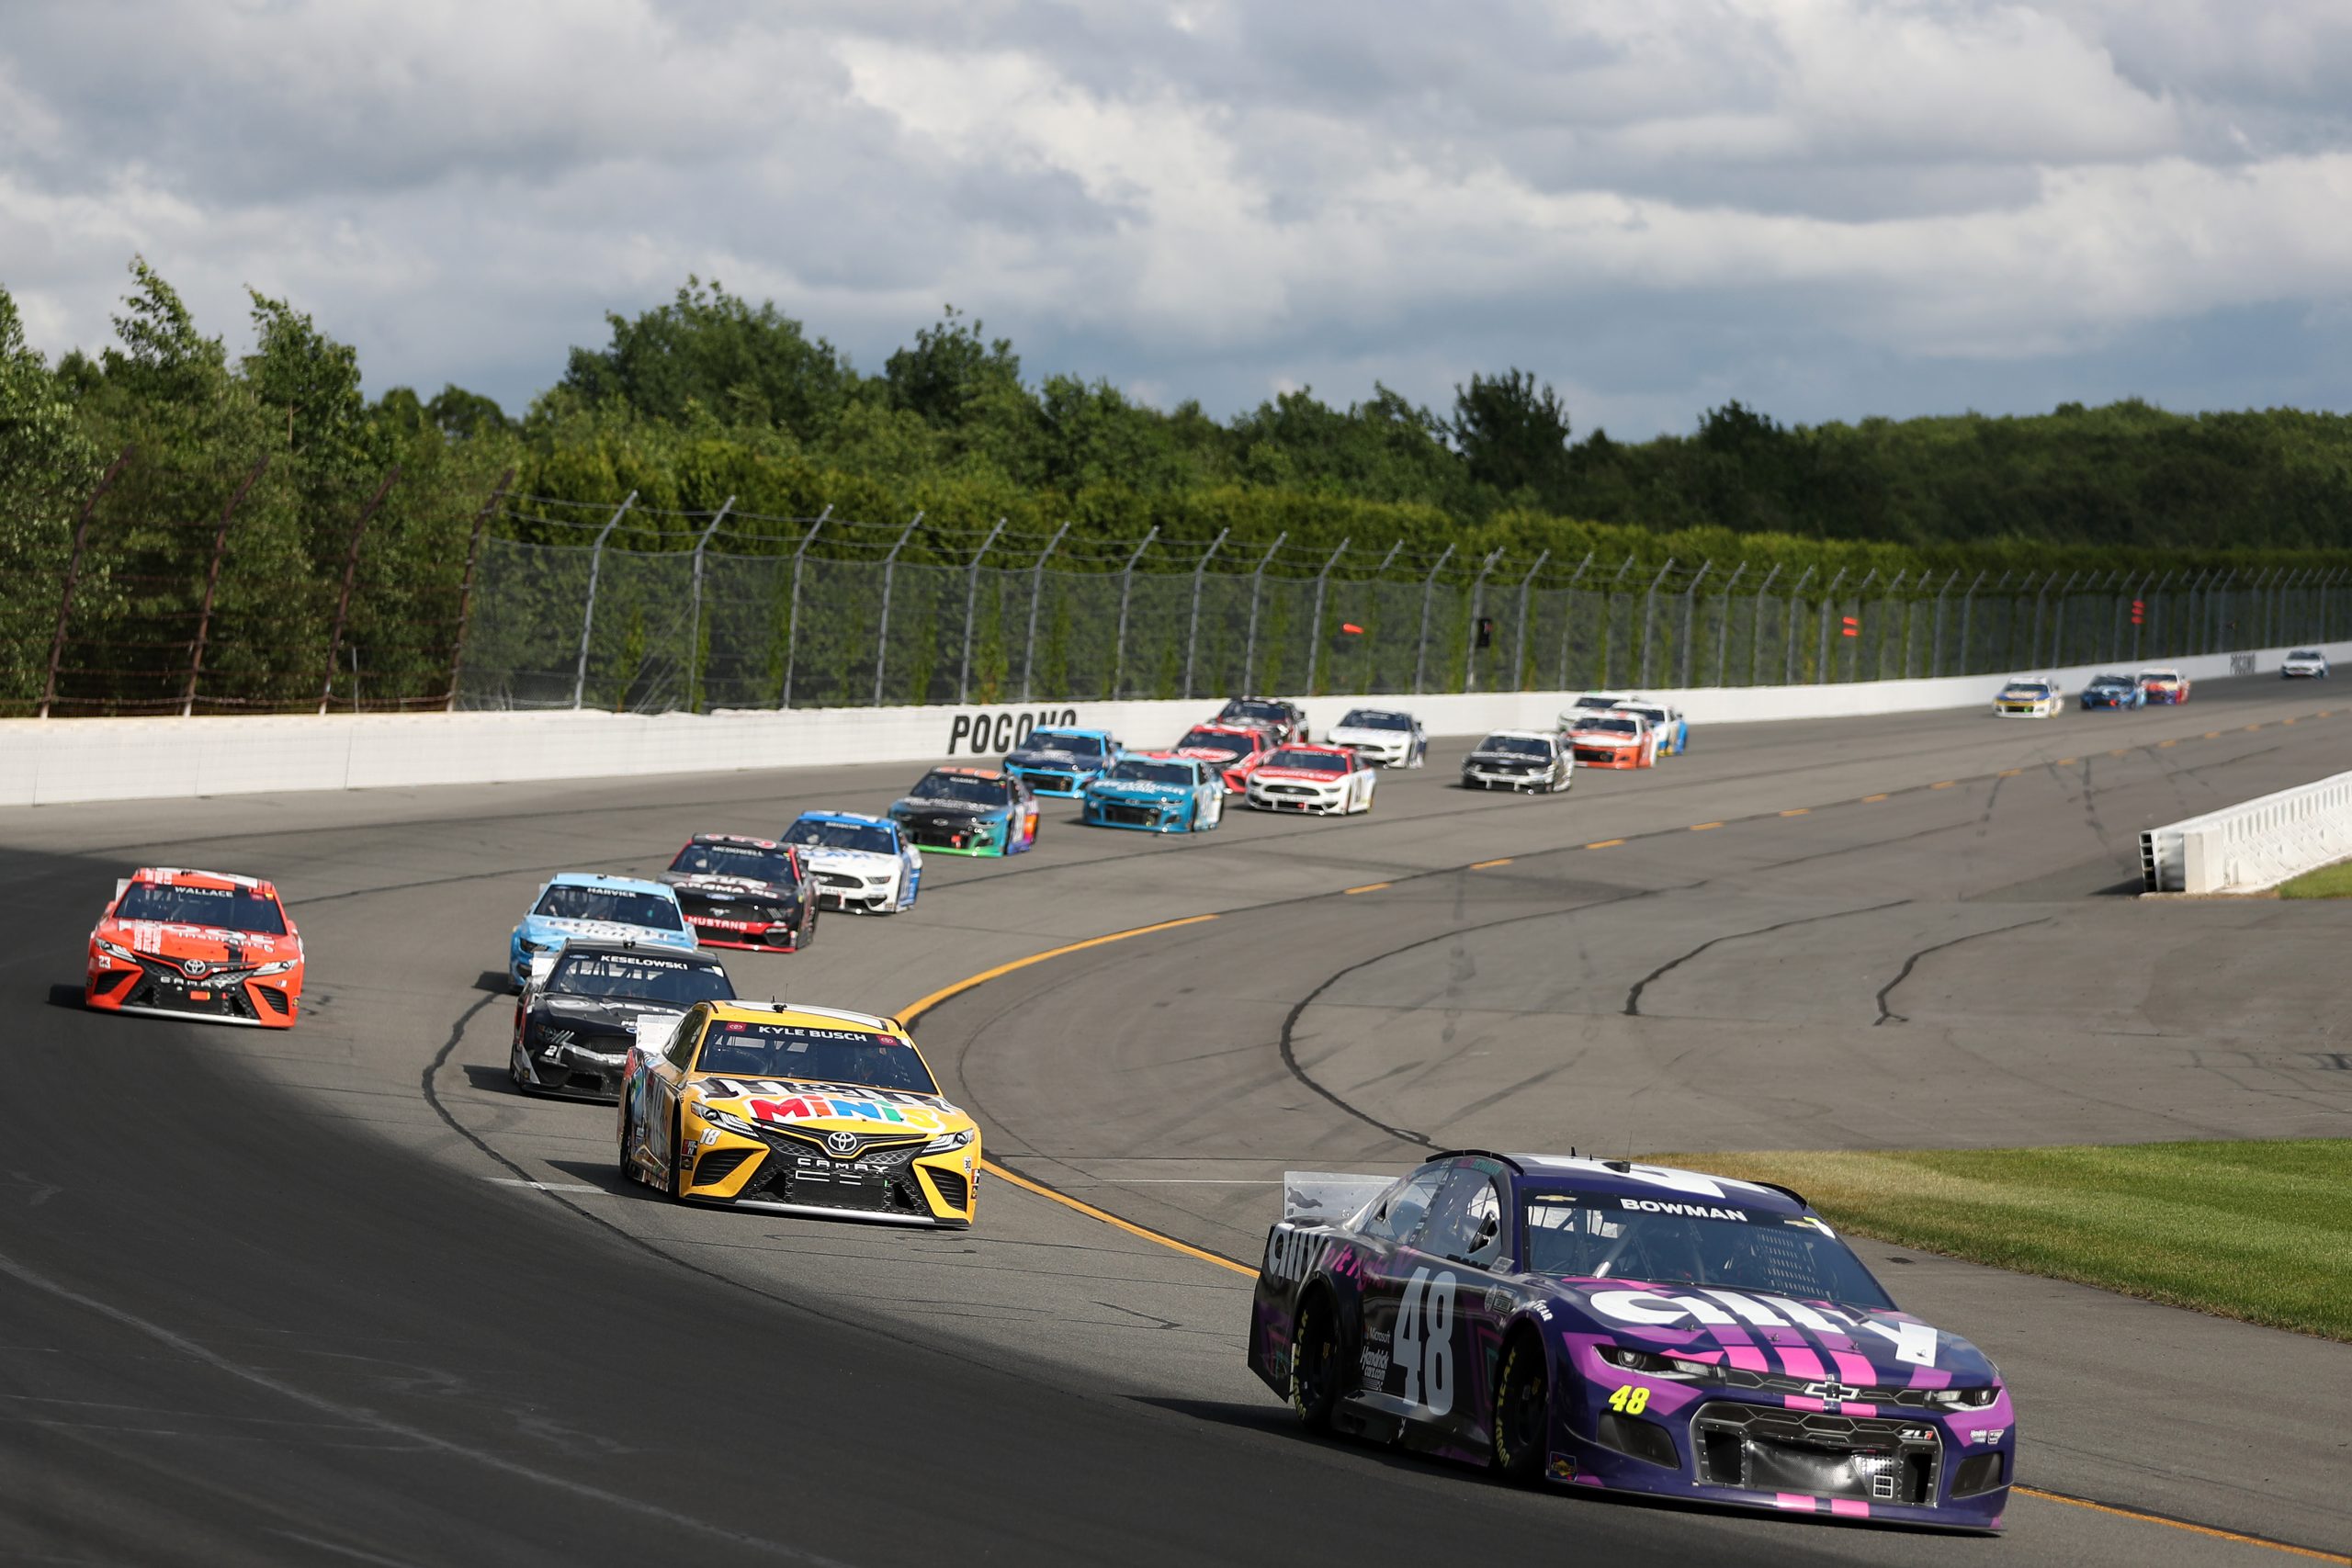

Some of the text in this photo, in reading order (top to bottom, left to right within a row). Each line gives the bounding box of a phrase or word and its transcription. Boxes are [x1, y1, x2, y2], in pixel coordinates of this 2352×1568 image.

[175, 886, 234, 898] WALLACE
[586, 886, 637, 898] HARVICK
[687, 915, 748, 931] MUSTANG
[98, 954, 111, 970] 23
[600, 954, 688, 971] KESELOWSKI
[758, 1025, 868, 1043] KYLE BUSCH
[543, 1044, 559, 1056] 2
[699, 1127, 723, 1146] 18
[797, 1156, 889, 1174] CAMRY
[1620, 1198, 1747, 1223] BOWMAN
[1269, 1224, 1332, 1283] ally
[1369, 1325, 1390, 1344] Microsoft
[1589, 1288, 1939, 1368] ally
[1393, 1266, 1457, 1416] 48
[1608, 1384, 1652, 1416] 48
